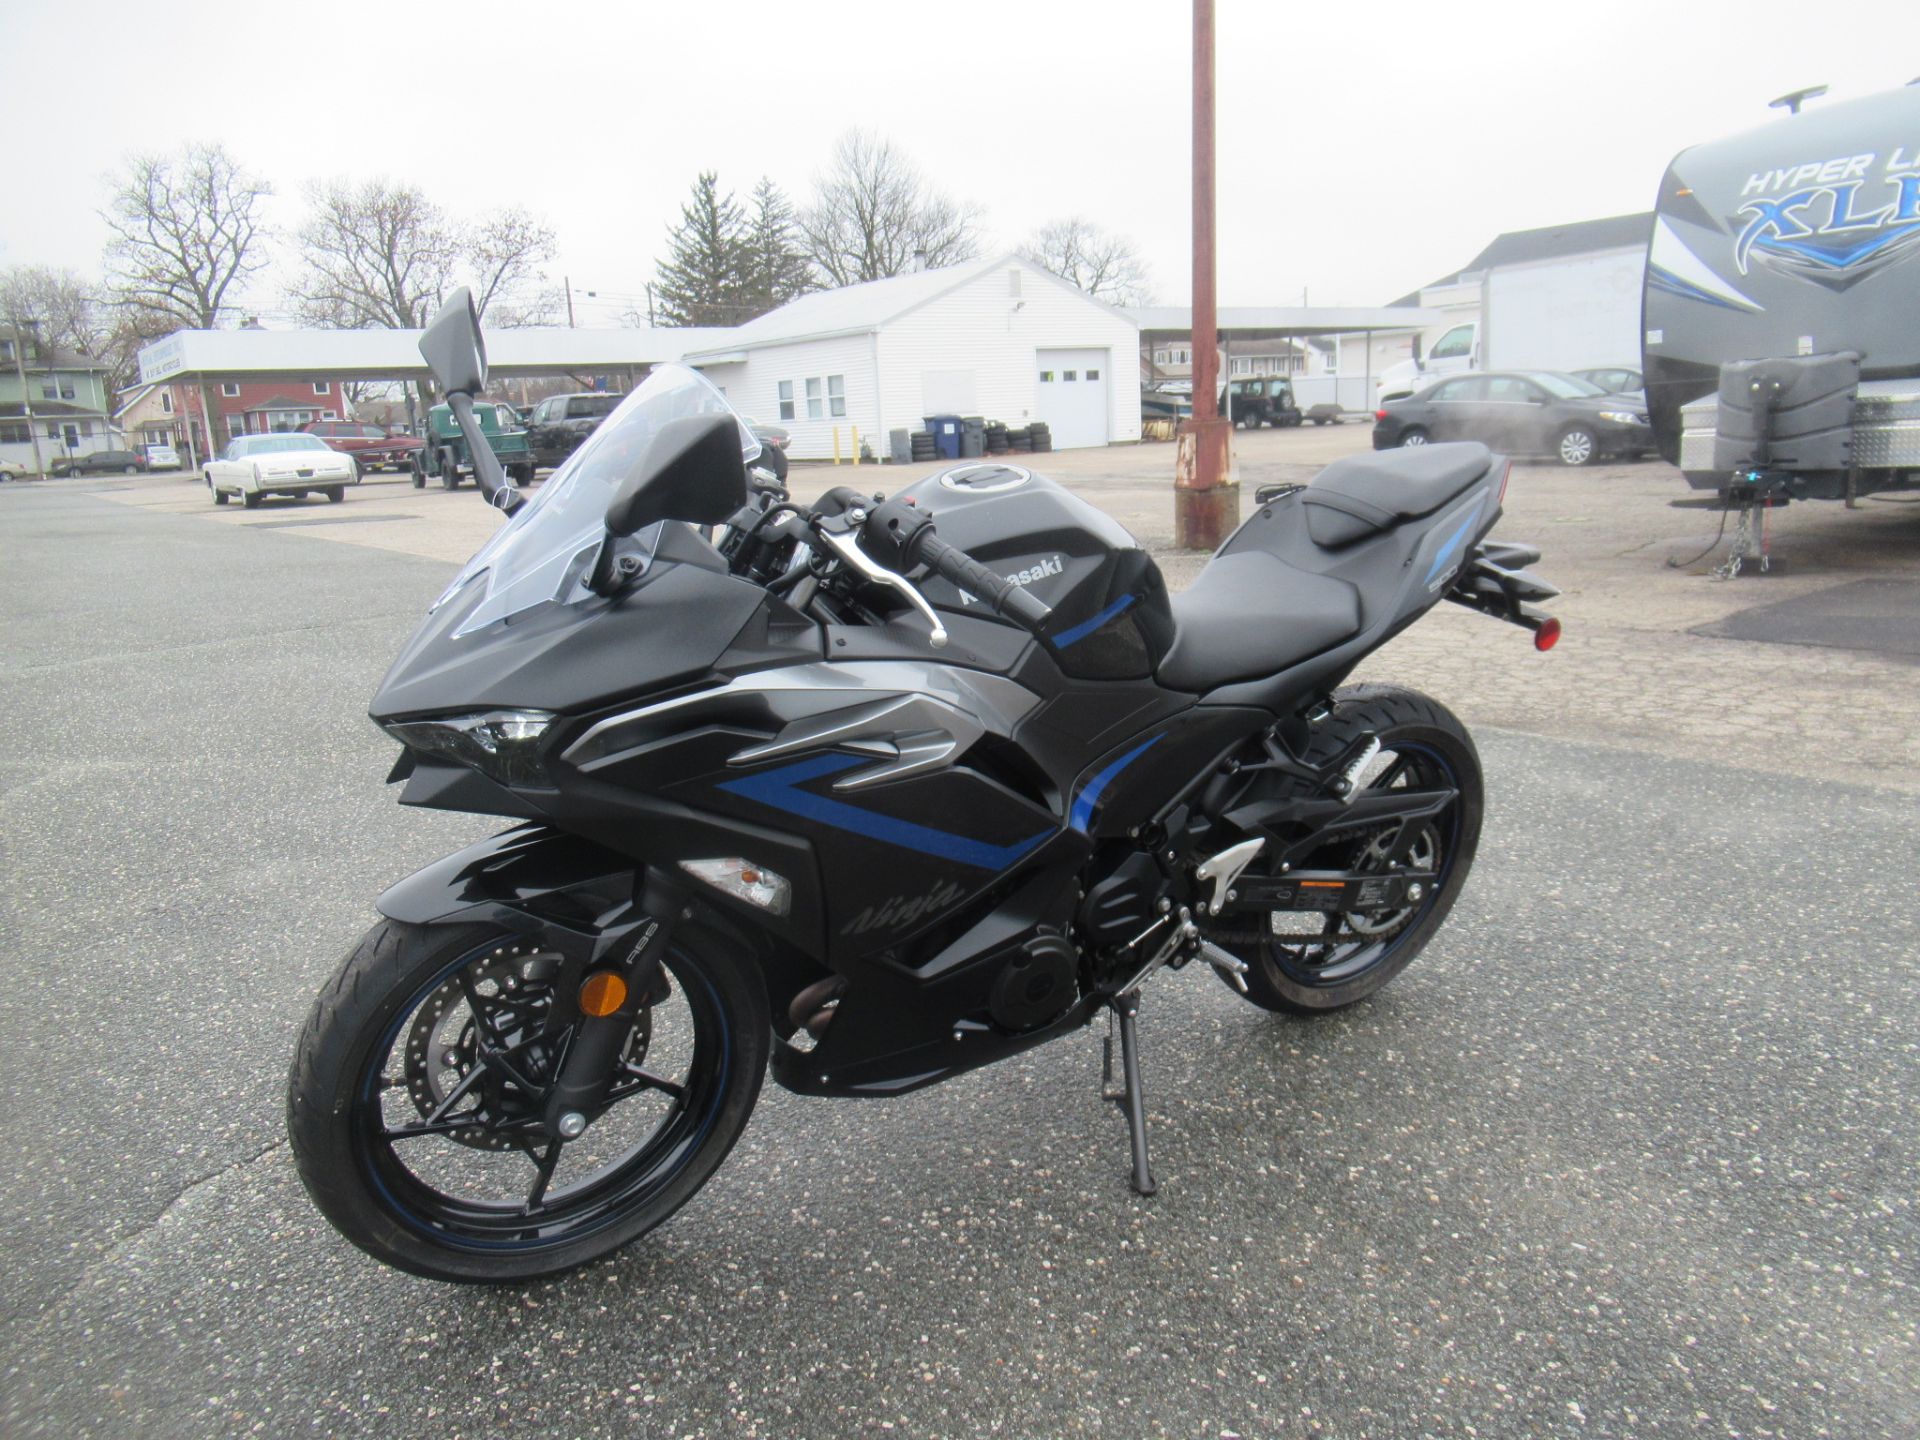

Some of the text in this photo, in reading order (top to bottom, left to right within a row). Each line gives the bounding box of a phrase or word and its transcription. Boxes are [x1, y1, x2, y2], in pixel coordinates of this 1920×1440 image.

[1740, 153, 1876, 197] HYPER
[958, 554, 1064, 606] Kasaki
[840, 878, 966, 935] Ninja
[625, 921, 659, 965] ABS
